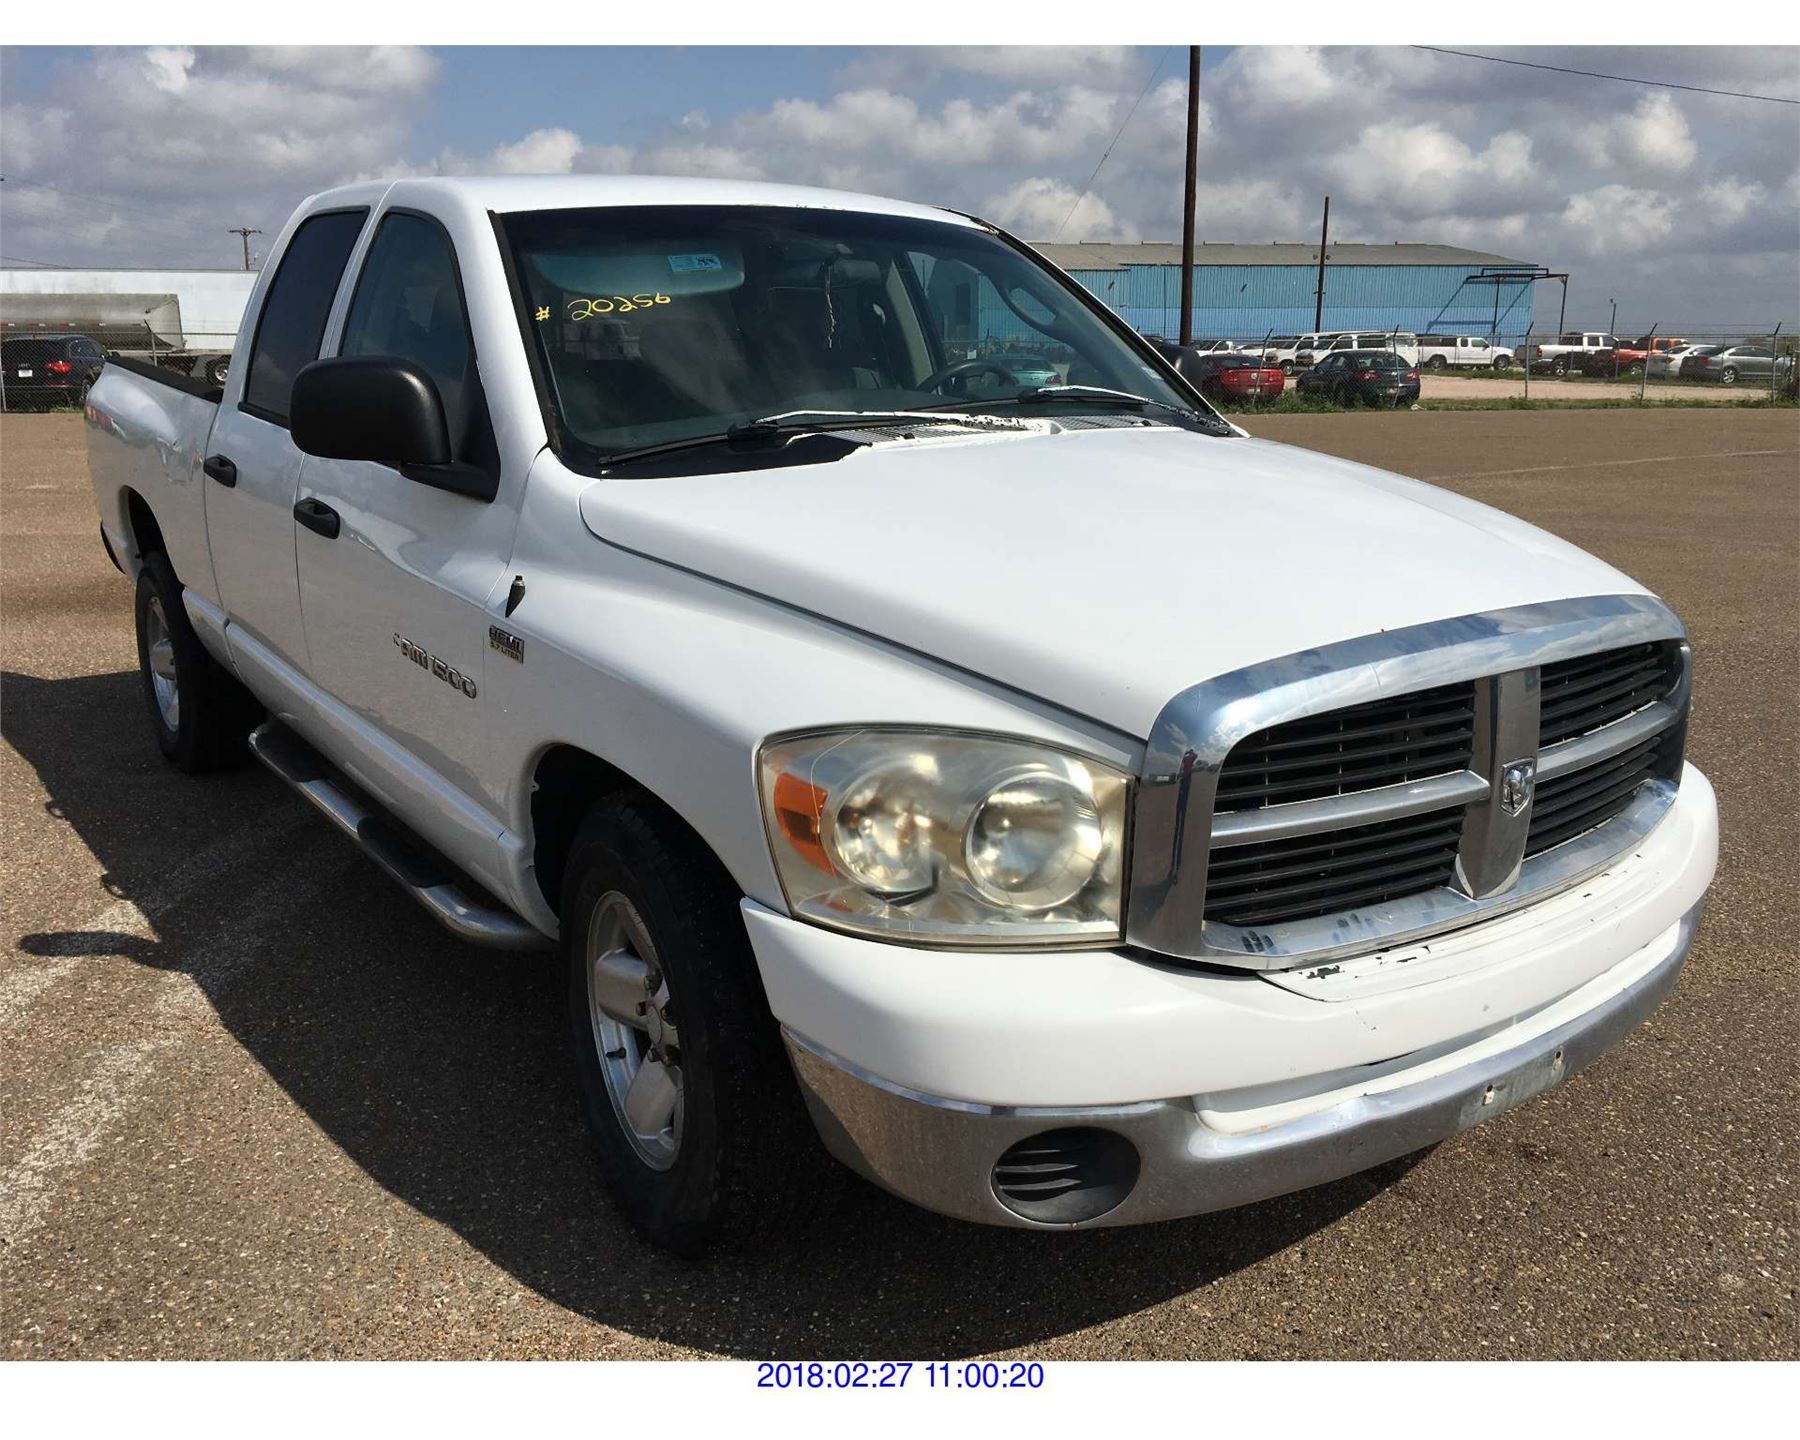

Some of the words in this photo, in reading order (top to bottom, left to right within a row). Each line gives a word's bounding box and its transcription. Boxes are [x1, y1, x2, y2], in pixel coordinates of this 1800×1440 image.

[535, 305, 551, 321] #
[567, 292, 671, 321] 20256
[430, 655, 477, 699] 1500
